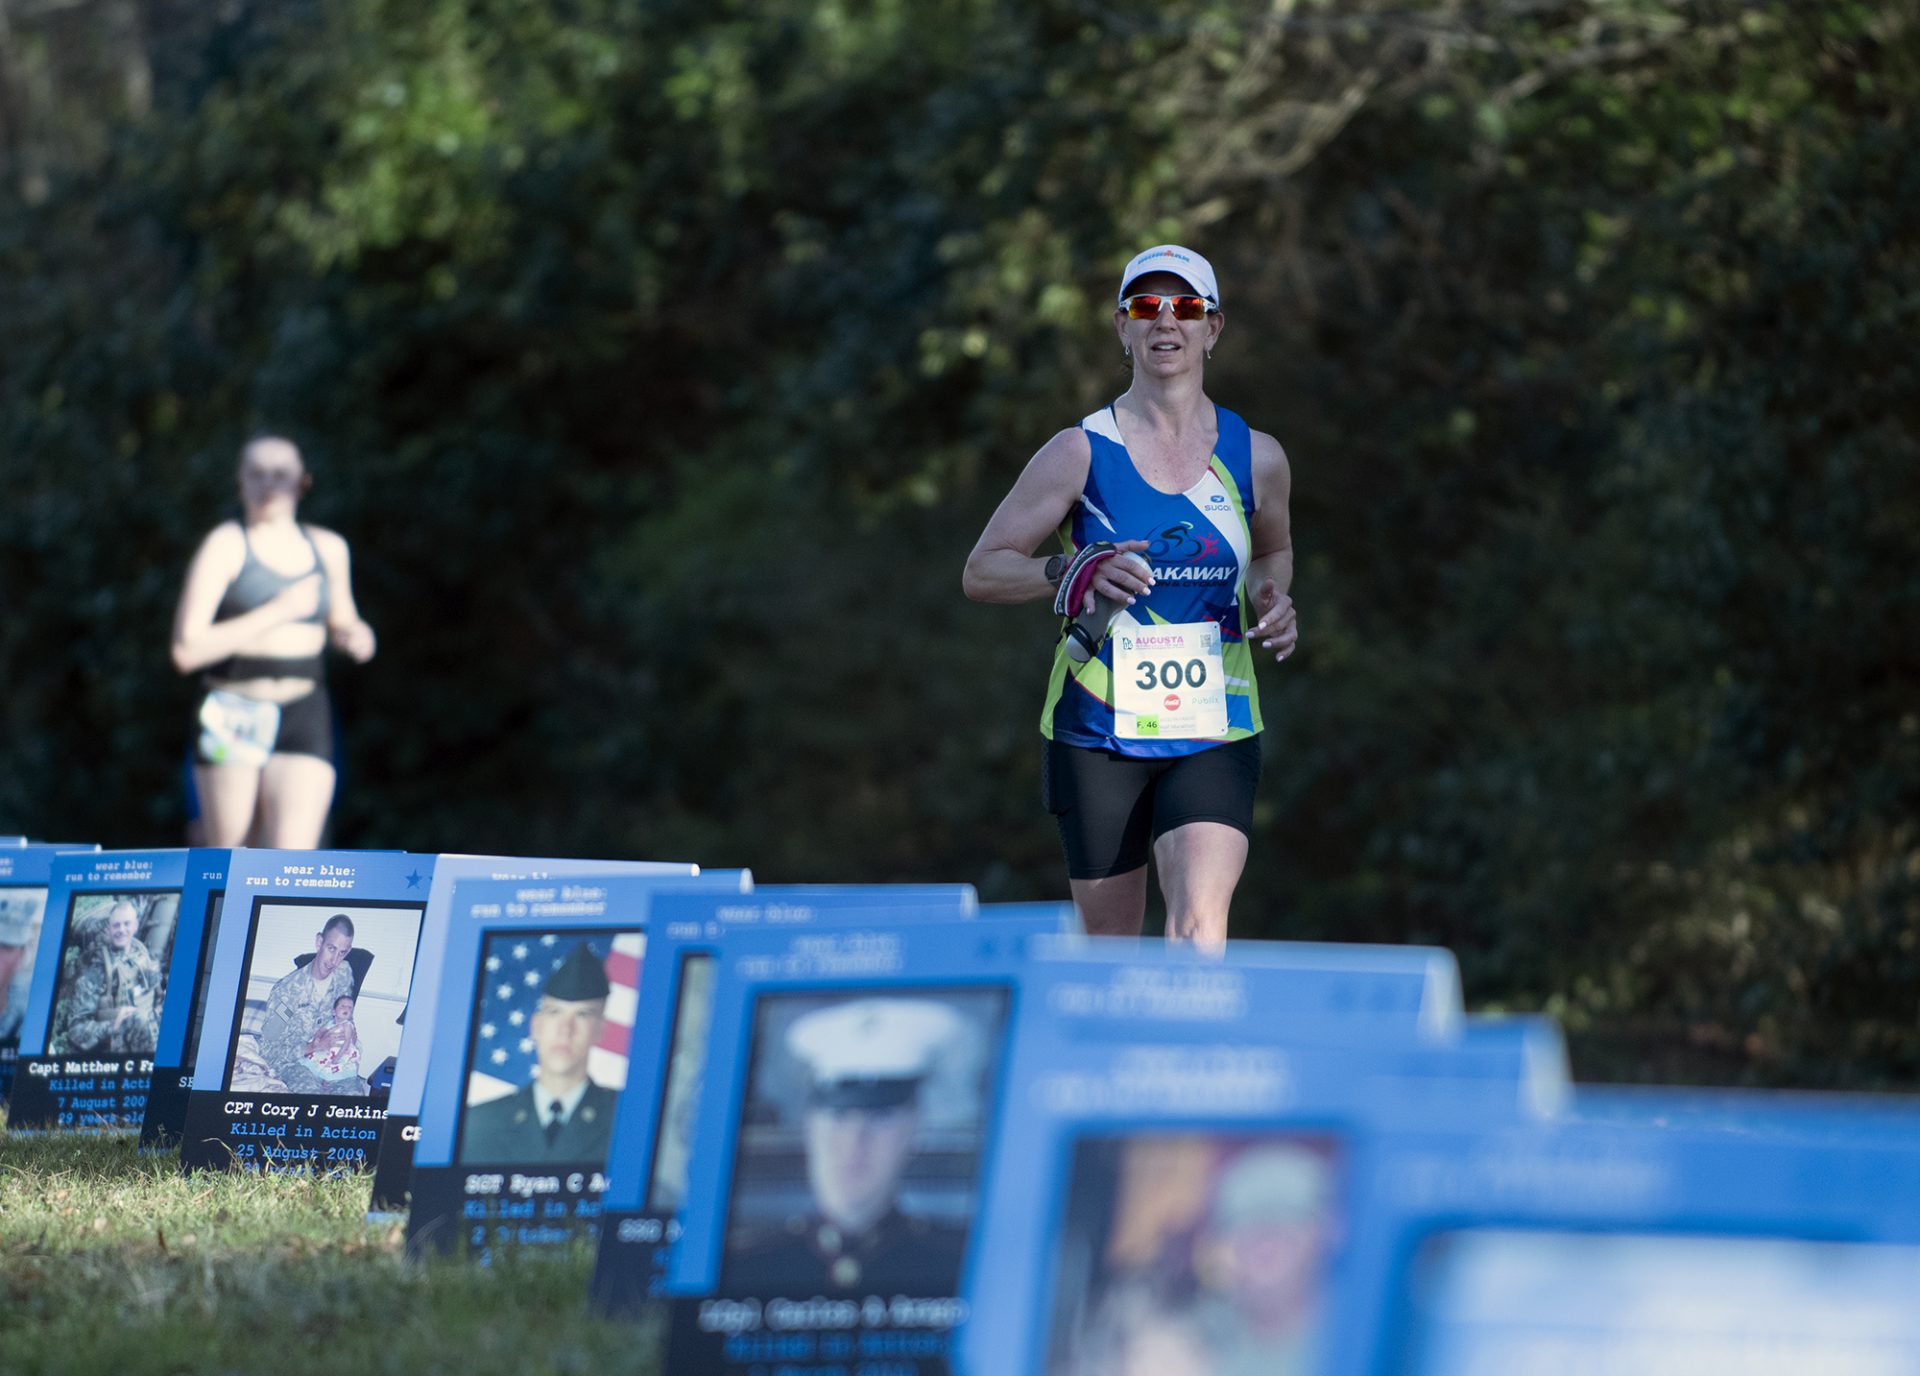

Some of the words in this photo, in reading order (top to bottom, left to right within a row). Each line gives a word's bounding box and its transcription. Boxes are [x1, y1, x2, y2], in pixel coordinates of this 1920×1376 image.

[1152, 566, 1236, 580] AKAWAY
[1136, 635, 1185, 645] AUGUSTA
[1135, 658, 1207, 690] 300
[1146, 721, 1158, 729] 46
[202, 871, 223, 880] run
[283, 865, 315, 875] wear
[320, 864, 356, 876] blue:
[245, 876, 269, 886] run
[274, 876, 290, 886] to
[294, 877, 356, 889] remember
[28, 1061, 60, 1077] Capt
[65, 1059, 120, 1074] Matthew
[124, 1059, 136, 1072] C
[140, 1059, 154, 1073] Fr
[49, 1078, 94, 1091] Killed
[100, 1079, 116, 1091] in
[121, 1077, 150, 1091] Acti
[58, 1097, 65, 1108] 7
[71, 1096, 117, 1110] August
[122, 1096, 148, 1108] 200
[224, 1101, 254, 1115] CPT
[261, 1103, 299, 1120] Cory
[307, 1105, 319, 1117] J
[326, 1105, 388, 1120] Jenkins
[230, 1122, 286, 1137] Killed
[295, 1124, 313, 1138] in
[321, 1127, 376, 1141] Action
[236, 1143, 255, 1157] 25
[262, 1145, 318, 1162] August
[326, 1147, 364, 1161] 2009
[509, 1174, 560, 1198] Ryan
[566, 1172, 584, 1193] C
[588, 1172, 611, 1193] A
